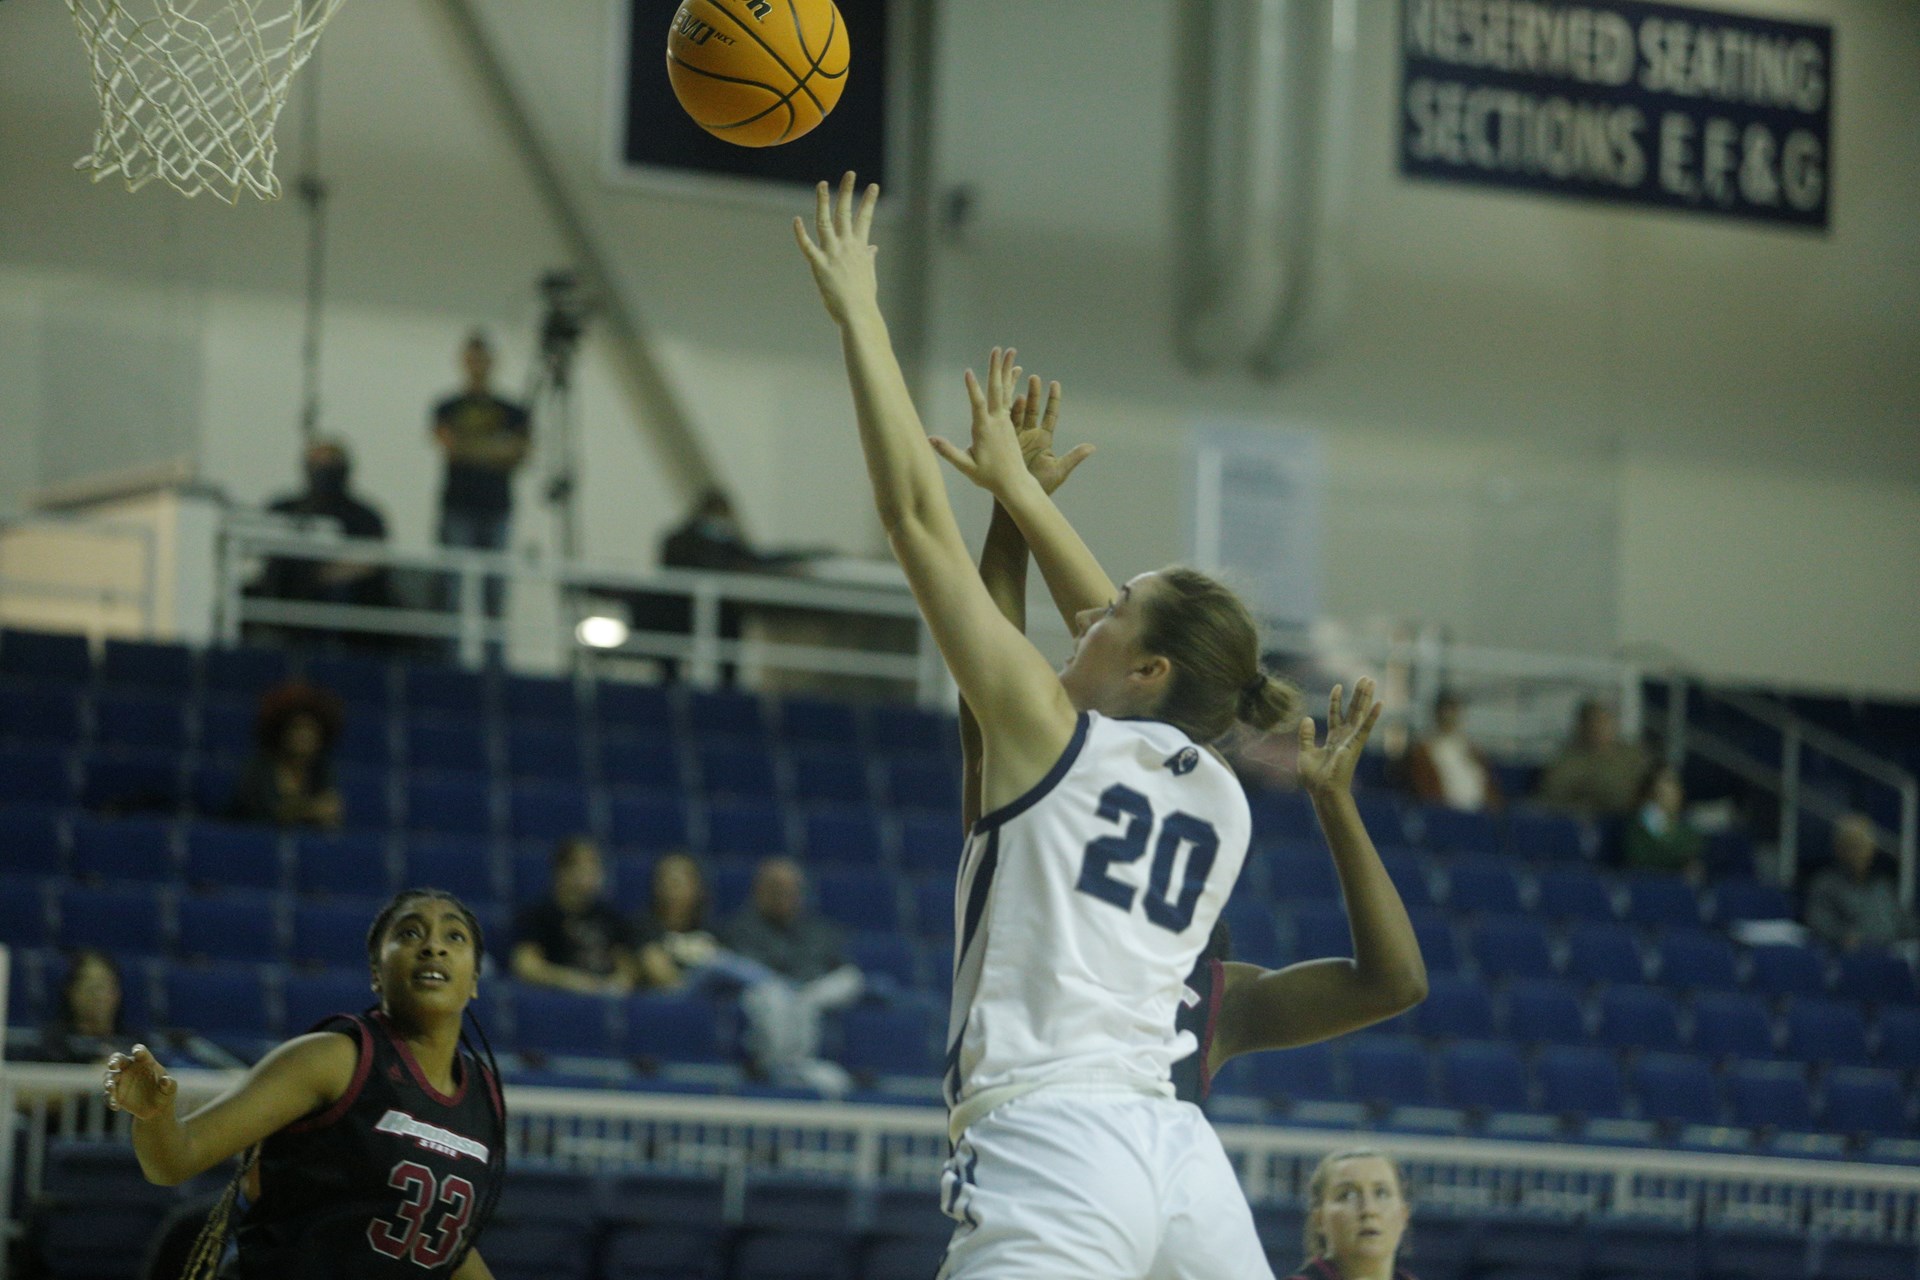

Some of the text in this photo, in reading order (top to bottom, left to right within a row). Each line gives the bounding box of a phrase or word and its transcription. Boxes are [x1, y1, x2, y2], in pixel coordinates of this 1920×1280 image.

[1638, 17, 1827, 113] SEATING
[1407, 79, 1648, 188] SECTIONS
[1781, 128, 1823, 212] G
[1075, 782, 1220, 935] 20
[418, 1138, 460, 1159] STATE
[366, 1160, 475, 1270] 33
